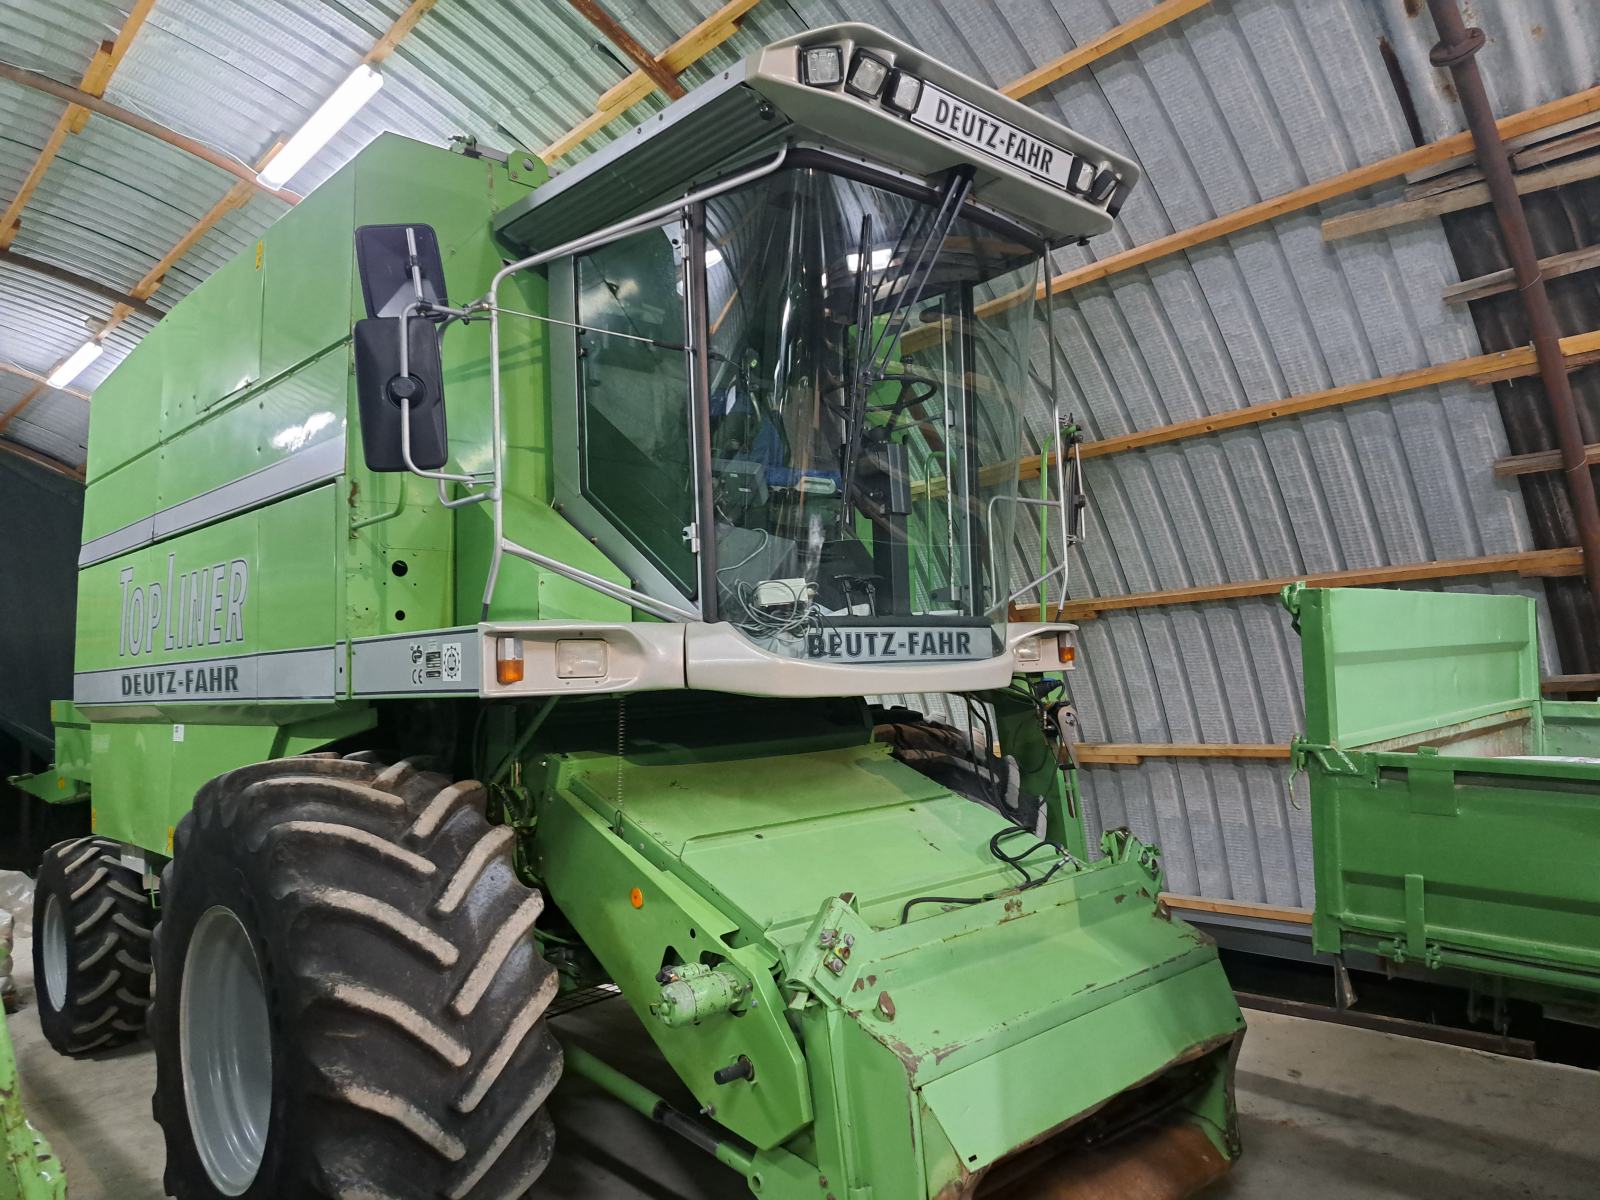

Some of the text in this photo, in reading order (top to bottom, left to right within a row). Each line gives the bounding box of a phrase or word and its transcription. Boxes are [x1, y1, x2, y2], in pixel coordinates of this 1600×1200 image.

[935, 98, 1053, 174] DEUTZ-FAHR
[808, 630, 972, 658] DEUTZ-FAHR
[121, 664, 239, 696] DEUTZ-FAHR
